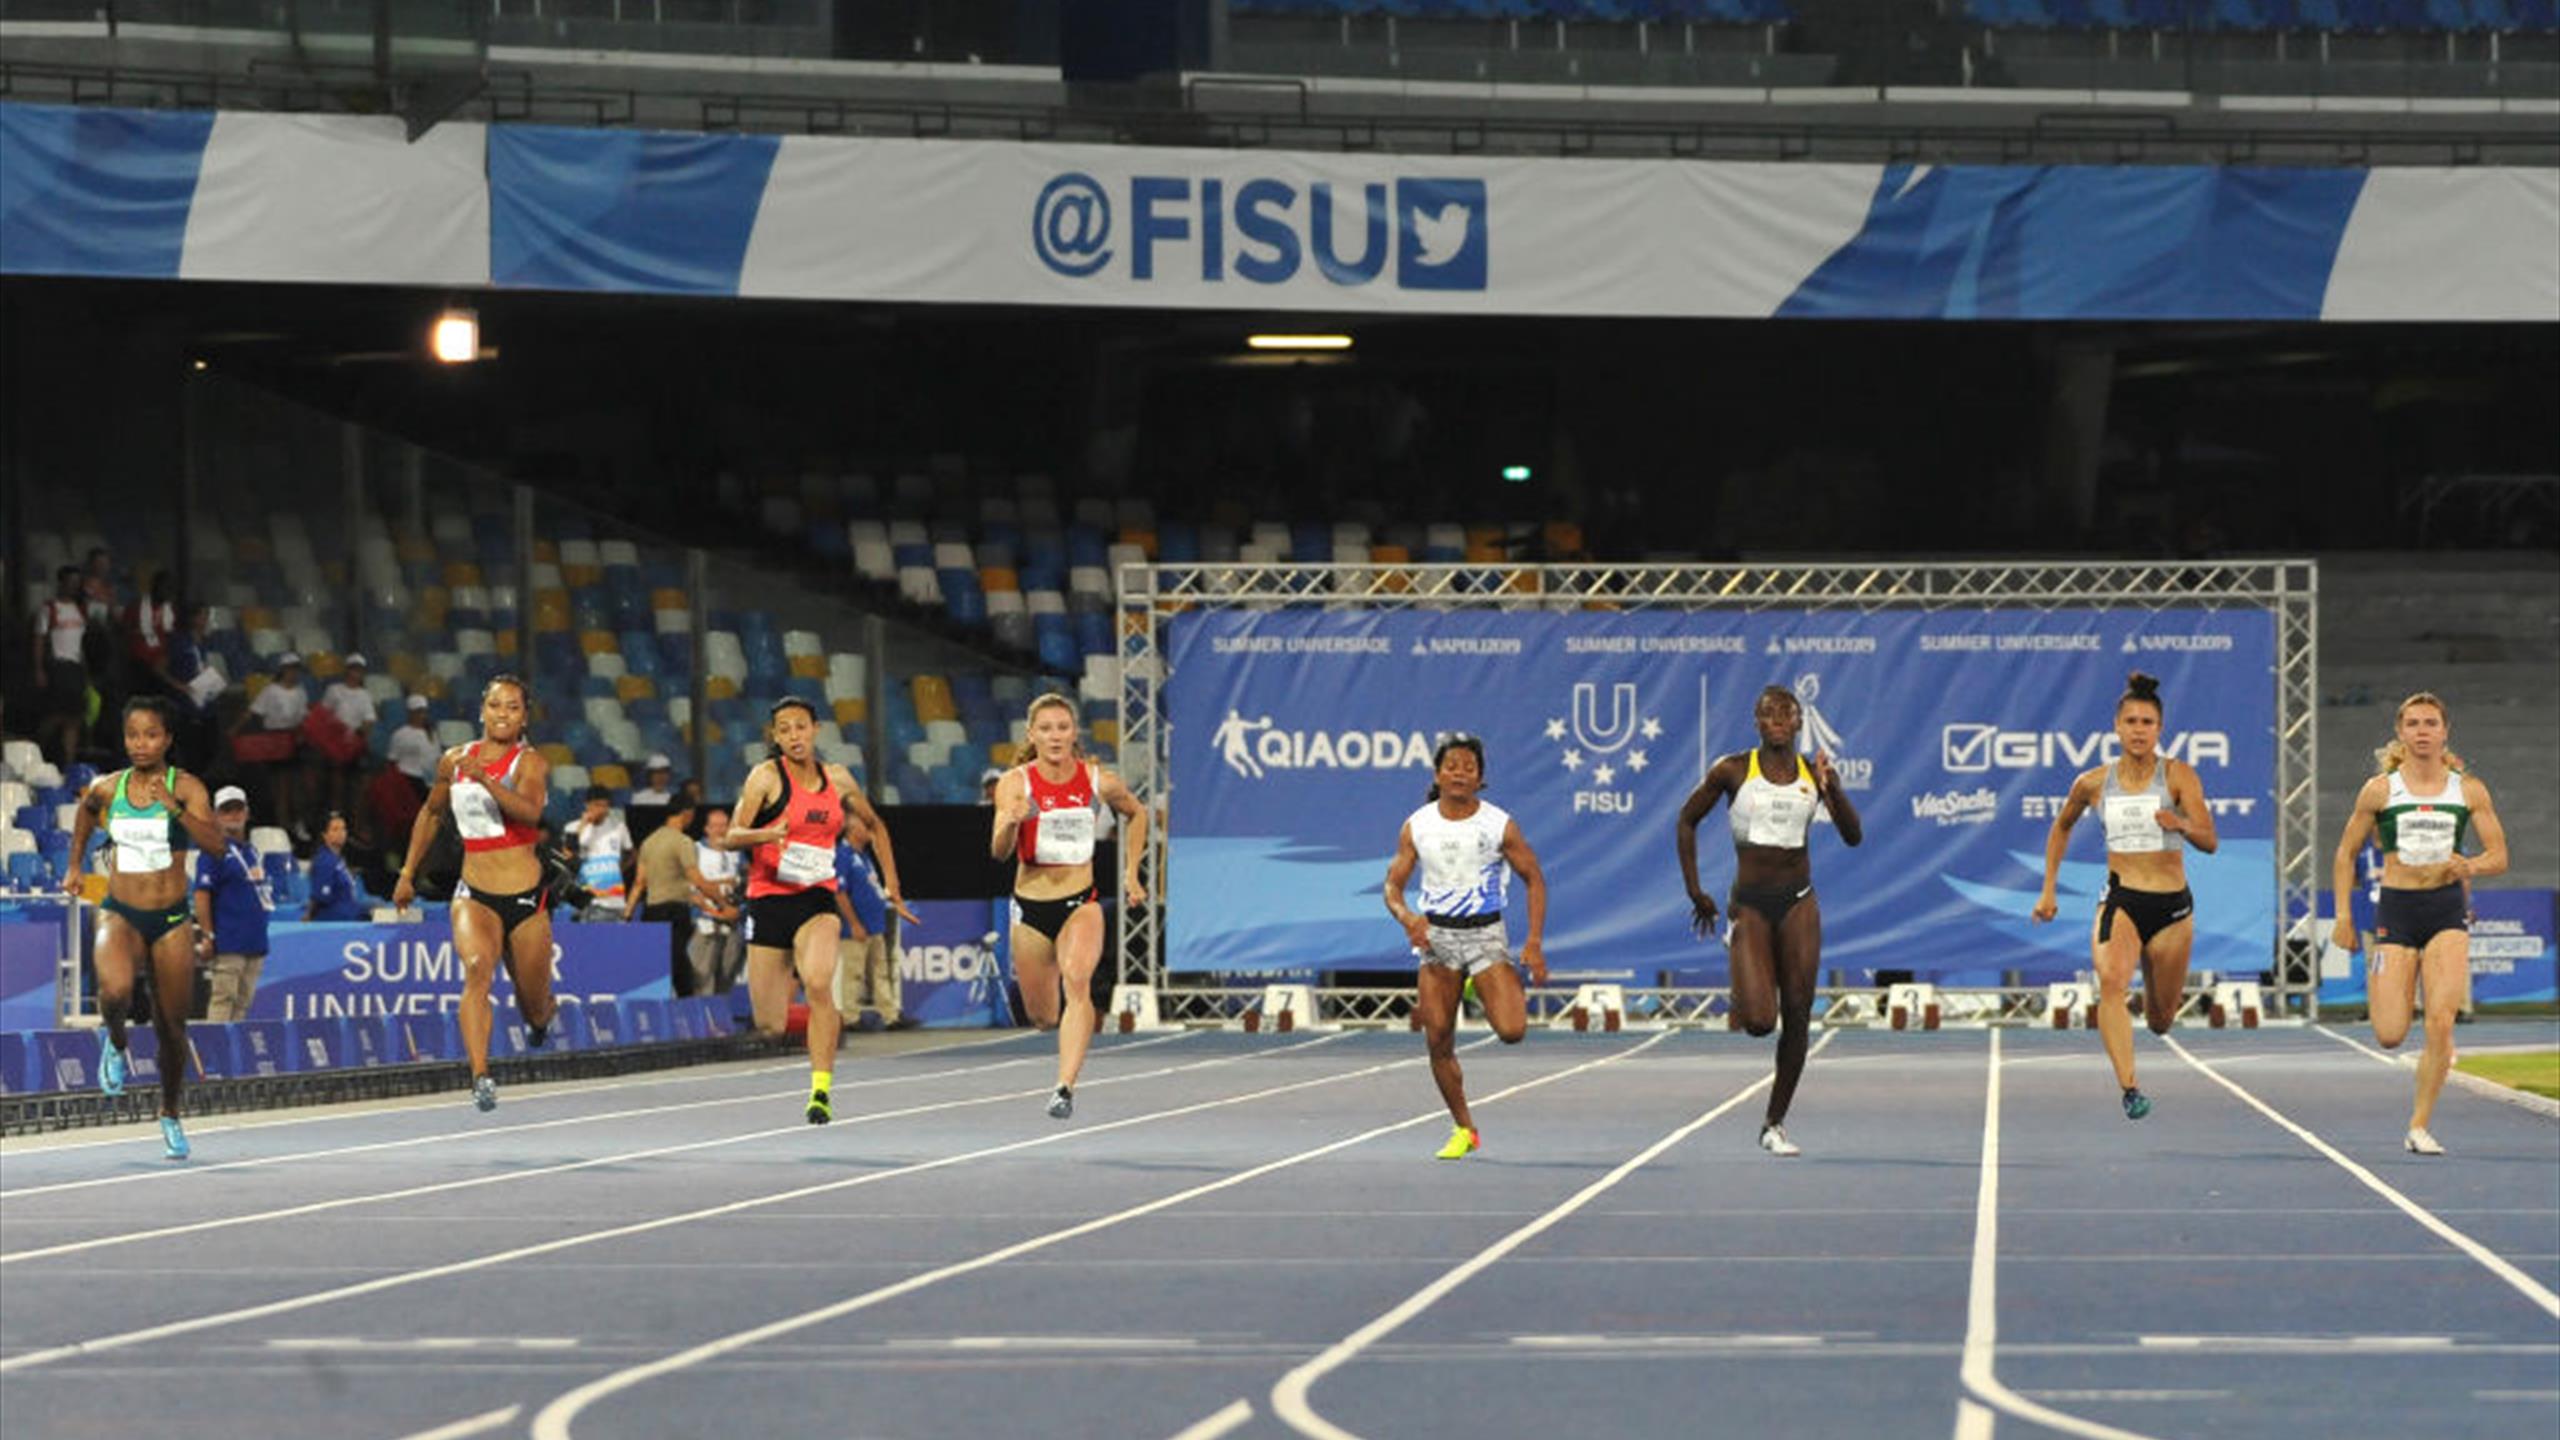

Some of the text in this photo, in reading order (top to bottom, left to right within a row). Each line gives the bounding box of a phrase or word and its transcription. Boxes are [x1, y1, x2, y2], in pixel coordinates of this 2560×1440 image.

[1033, 172, 1389, 286] @FISU
[1213, 637, 1390, 654] SUMMER UNIVERSIADE
[1566, 636, 1746, 653] SUMMER UNIVERSIADE
[1920, 635, 2101, 651] SUMMER UNIVERSIADE
[1257, 730, 1468, 769] QIAODA
[1828, 758, 1873, 782] 019
[1574, 791, 1634, 813] FISU
[342, 940, 563, 982] SUMR
[897, 945, 981, 982] MBO
